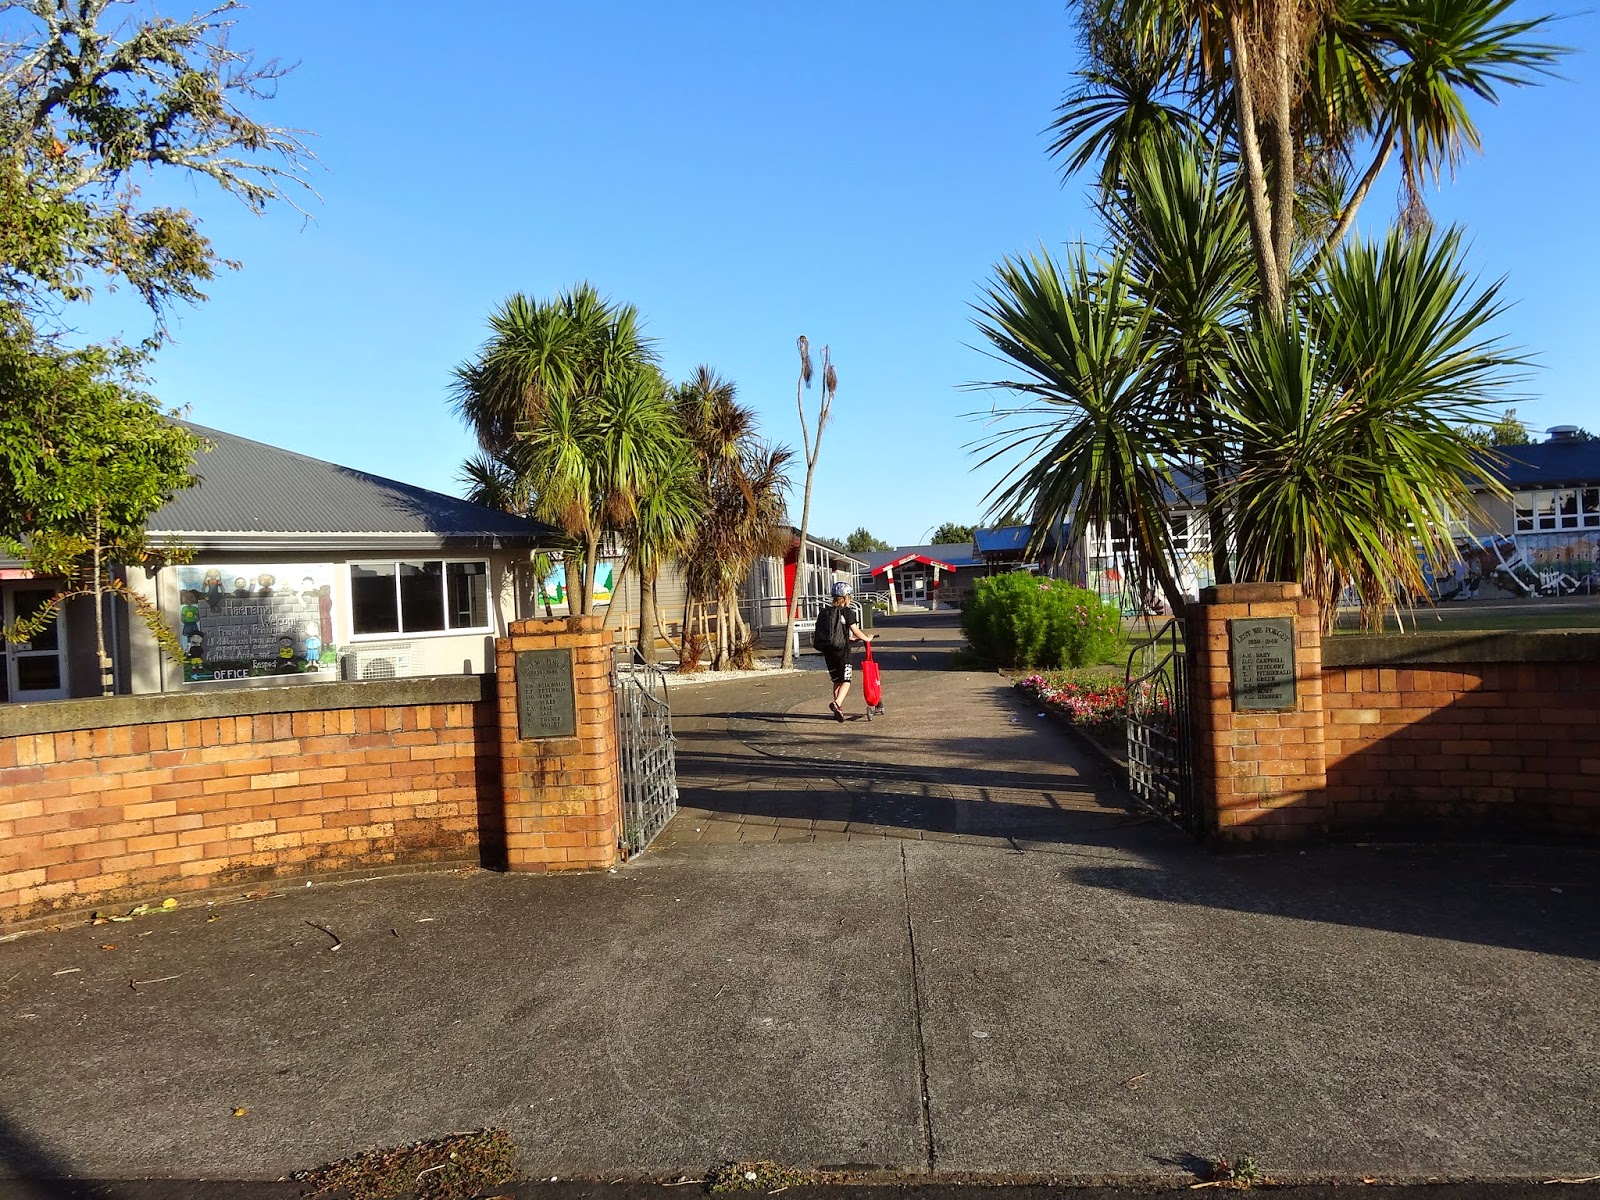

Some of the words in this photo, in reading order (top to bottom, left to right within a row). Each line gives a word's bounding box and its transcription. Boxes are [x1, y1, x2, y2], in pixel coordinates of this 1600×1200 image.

[259, 615, 303, 628] Welcome
[1235, 629, 1251, 644] LEST
[1251, 626, 1264, 634] WE
[1265, 626, 1291, 642] FORGET
[252, 659, 278, 671] Respect
[213, 668, 249, 680] OFFICE
